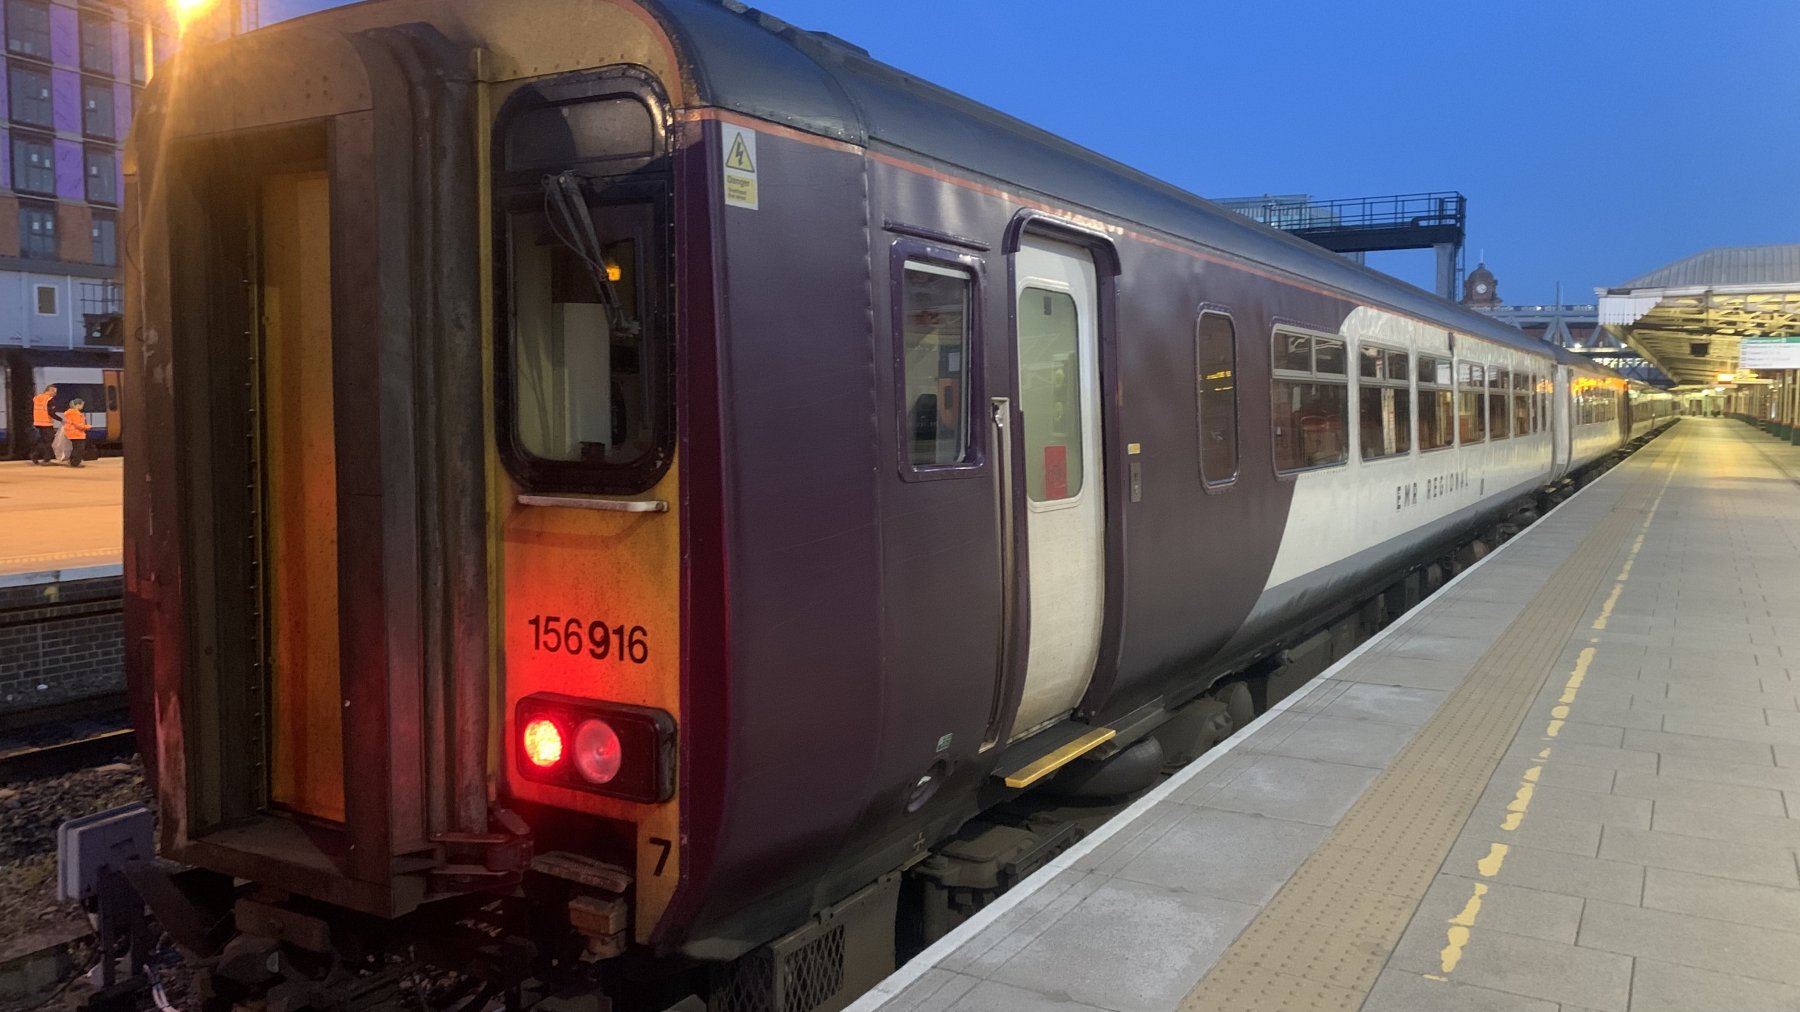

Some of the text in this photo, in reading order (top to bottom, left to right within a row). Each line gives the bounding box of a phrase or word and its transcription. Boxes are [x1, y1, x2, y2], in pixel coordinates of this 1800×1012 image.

[727, 175, 750, 187] Danger
[1396, 470, 1469, 510] EMR REGIONAL
[528, 615, 648, 664] 156916
[649, 837, 672, 877] 7
